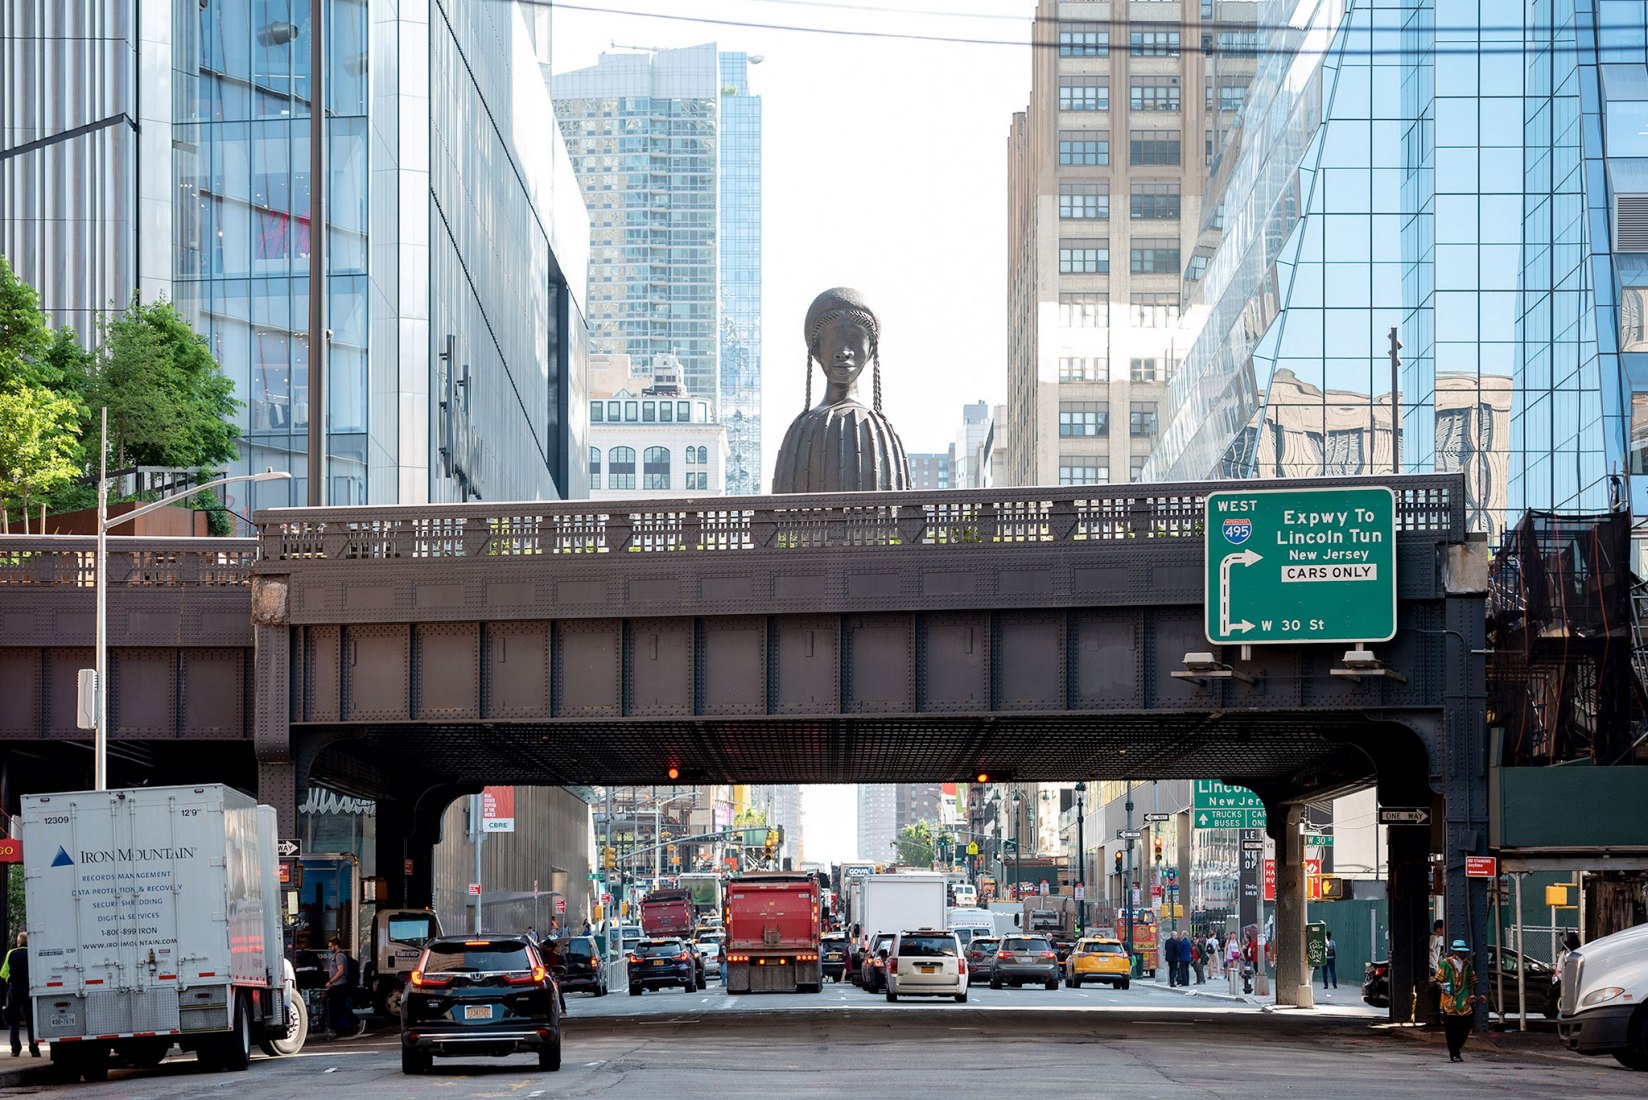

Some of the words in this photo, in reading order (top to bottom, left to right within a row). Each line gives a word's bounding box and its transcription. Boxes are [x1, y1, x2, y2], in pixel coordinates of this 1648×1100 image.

[1217, 500, 1257, 512] WEST
[1283, 510, 1348, 527] Expwy
[1354, 508, 1375, 523] To
[1225, 525, 1249, 538] 495
[1277, 530, 1343, 545] Lincoln
[1349, 528, 1382, 543] Tun
[1289, 549, 1317, 561] New
[1322, 549, 1369, 562] Jersey
[1287, 567, 1327, 579] CARS
[1332, 566, 1371, 578] ONLY
[1261, 620, 1272, 631] W
[1281, 620, 1300, 631] 30
[1309, 619, 1324, 630] St
[1198, 780, 1252, 793] Linco
[1209, 796, 1235, 806] New
[1238, 796, 1264, 806] Jer
[1211, 810, 1242, 818] TRUCKS
[1251, 810, 1267, 818] CAR
[44, 816, 69, 825] 12309
[1214, 819, 1241, 827] BUSES
[1251, 819, 1267, 827] ONL
[1308, 836, 1314, 844] W
[1316, 836, 1326, 845] 30
[80, 849, 115, 864] IRON
[118, 847, 194, 862] MOUNTAIN
[82, 873, 115, 882] RECORDS
[117, 871, 171, 880] MANAGEMENT
[147, 884, 182, 892] RECOVEY
[121, 898, 163, 907] SHRDDING
